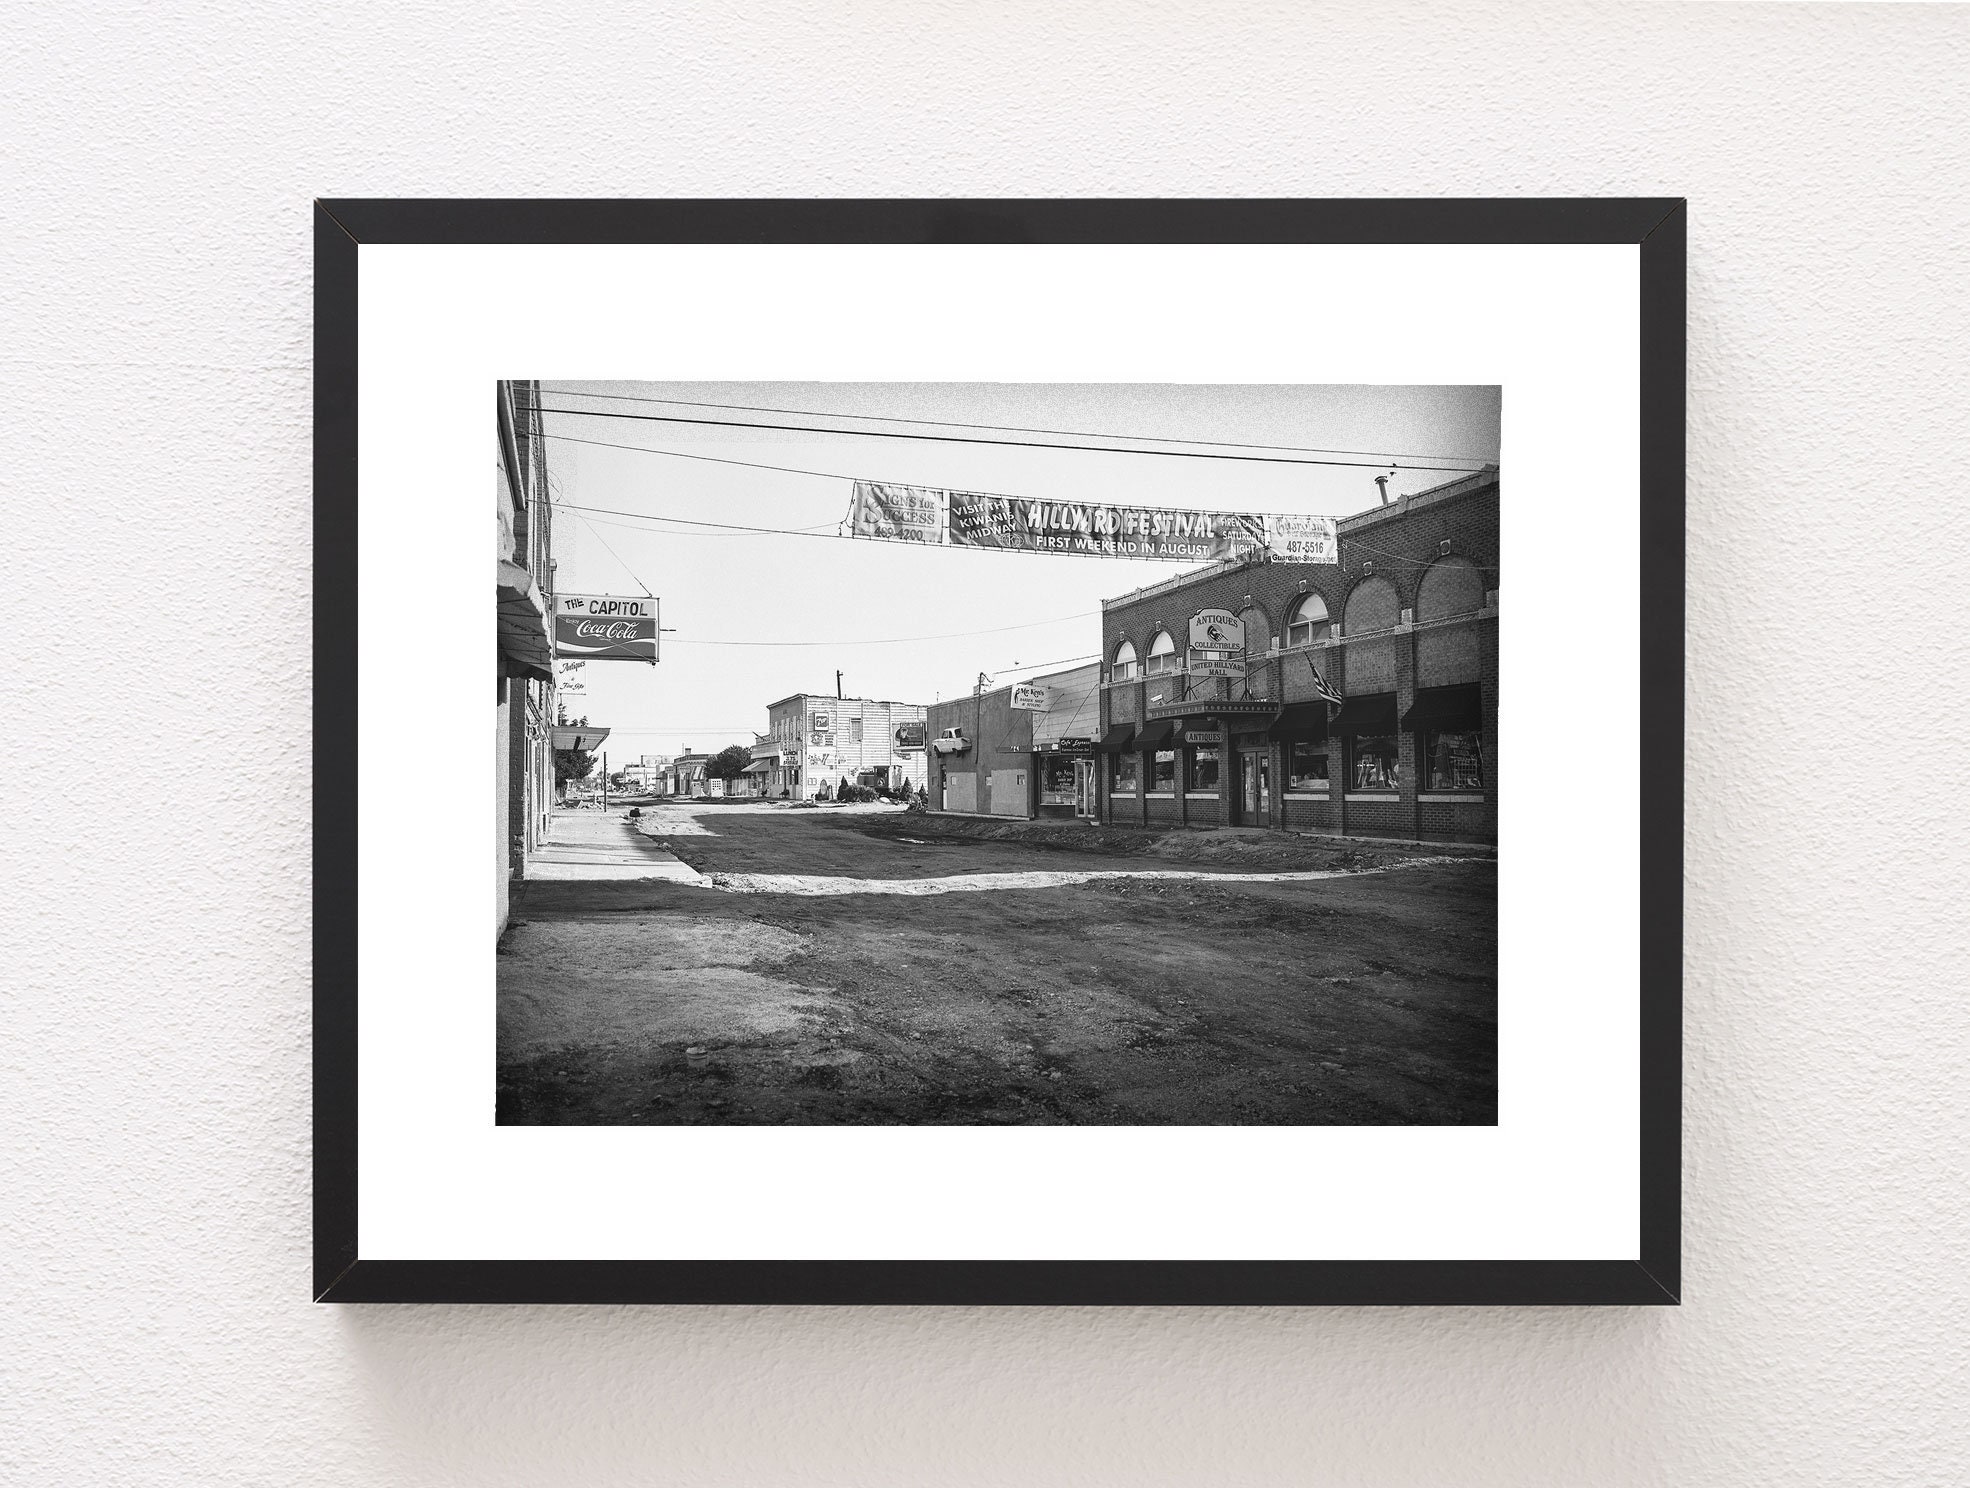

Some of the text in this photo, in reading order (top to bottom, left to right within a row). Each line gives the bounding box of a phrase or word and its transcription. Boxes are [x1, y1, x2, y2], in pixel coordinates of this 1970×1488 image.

[866, 486, 935, 509] SIGNS for
[863, 499, 935, 525] SUCCESS
[952, 499, 1011, 516] VISIT THE
[959, 512, 1015, 528] KIWANIS
[1027, 503, 1215, 538] HILLYARD FESTIVAL
[966, 522, 1017, 540] MIDWAY
[1222, 530, 1263, 541] SATURDAY
[1036, 535, 1208, 556] FIRST WEEKEND IN AUGUST
[1230, 544, 1256, 554] NIGHT
[1286, 540, 1324, 554] 487-5516
[564, 598, 648, 616] THE CAPITOL
[576, 619, 640, 639] Coca-Cola
[1195, 614, 1238, 628] ANTIQUES
[1194, 641, 1241, 649] COLLECTIBLES
[559, 660, 586, 673] Antiques
[1214, 661, 1245, 672] HILLYARD
[1189, 733, 1221, 742] ANTIQUES
